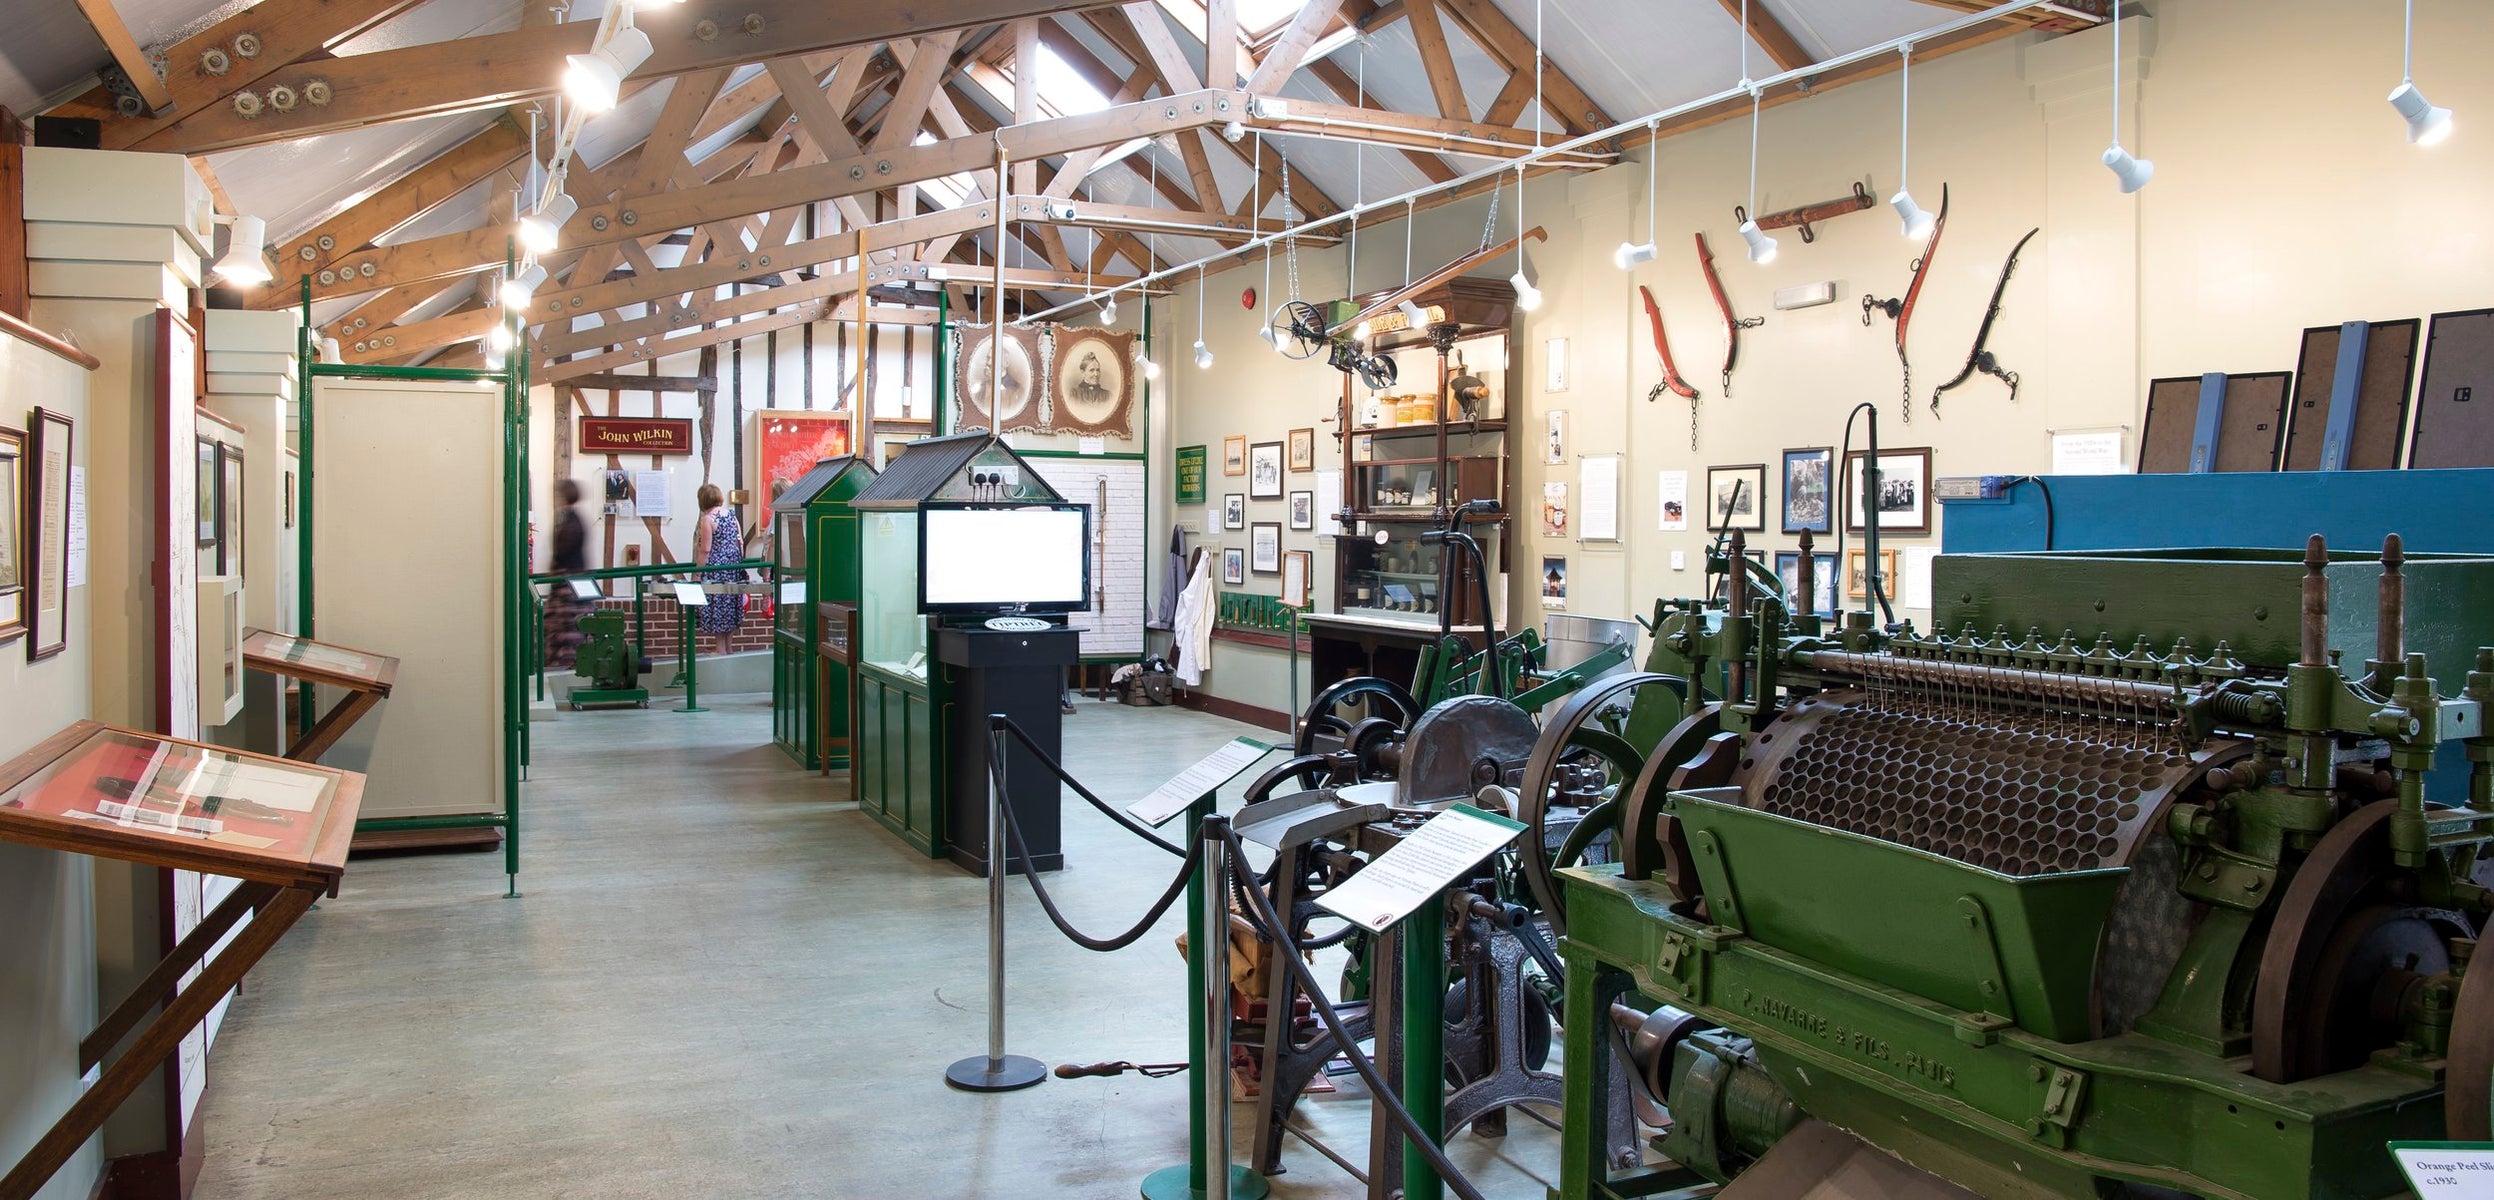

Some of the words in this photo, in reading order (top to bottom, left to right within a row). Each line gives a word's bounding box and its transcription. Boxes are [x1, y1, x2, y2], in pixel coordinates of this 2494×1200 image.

[598, 431, 630, 443] JOHN
[633, 429, 673, 442] WILKIN
[1763, 996, 1828, 1039] NAVARRE
[1834, 1025, 1847, 1046] &
[2416, 1161, 2456, 1172] Orange
[2456, 1161, 2479, 1171] Peel
[2427, 1177, 2458, 1185] c.1930
